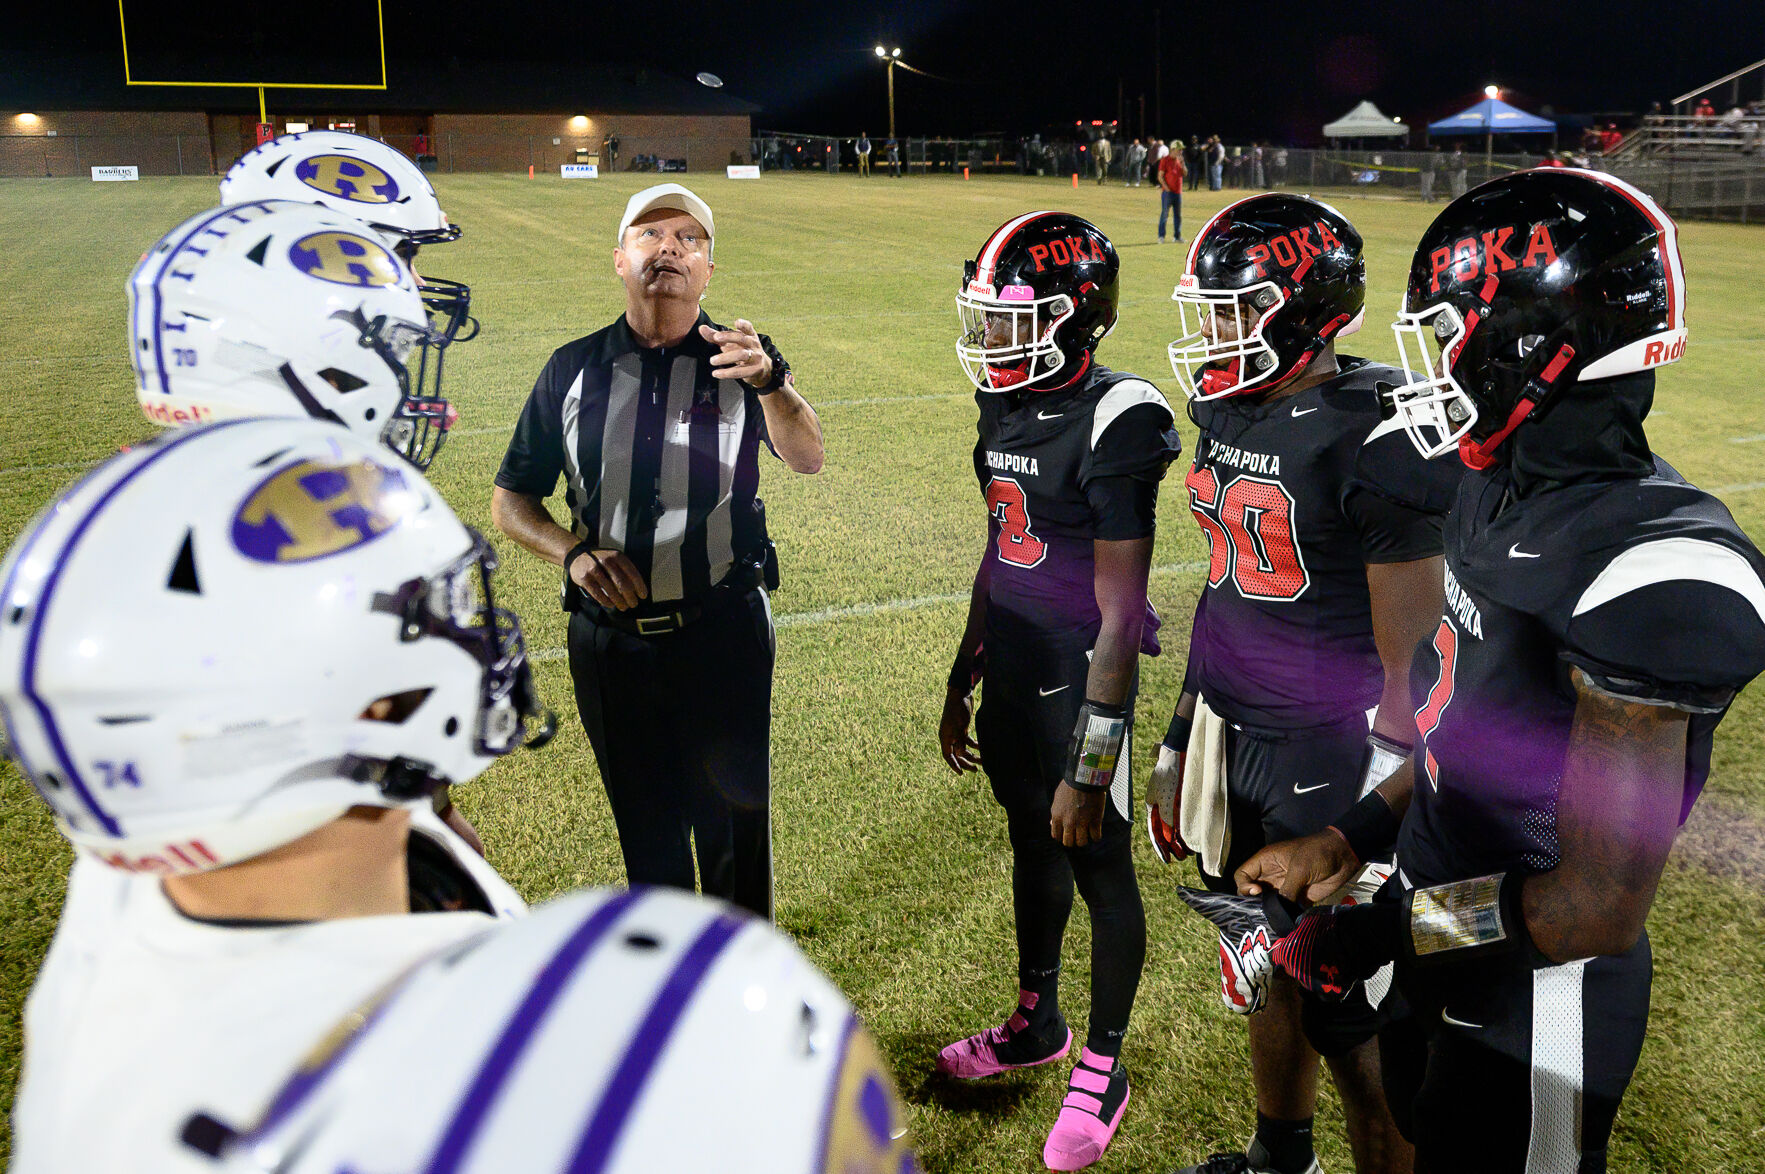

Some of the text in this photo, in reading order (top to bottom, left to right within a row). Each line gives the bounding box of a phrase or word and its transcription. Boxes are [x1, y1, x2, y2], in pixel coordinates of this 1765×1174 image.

[261, 123, 271, 137] P
[304, 154, 391, 204] R
[297, 231, 401, 287] R
[1028, 235, 1106, 273] POKA
[1245, 221, 1343, 279] POKA
[1429, 224, 1560, 294] POKA
[1643, 334, 1688, 366] Ridd
[985, 450, 1039, 476] CHAPOKA
[1207, 439, 1280, 475] ACHAPOKA
[94, 760, 142, 789] 74
